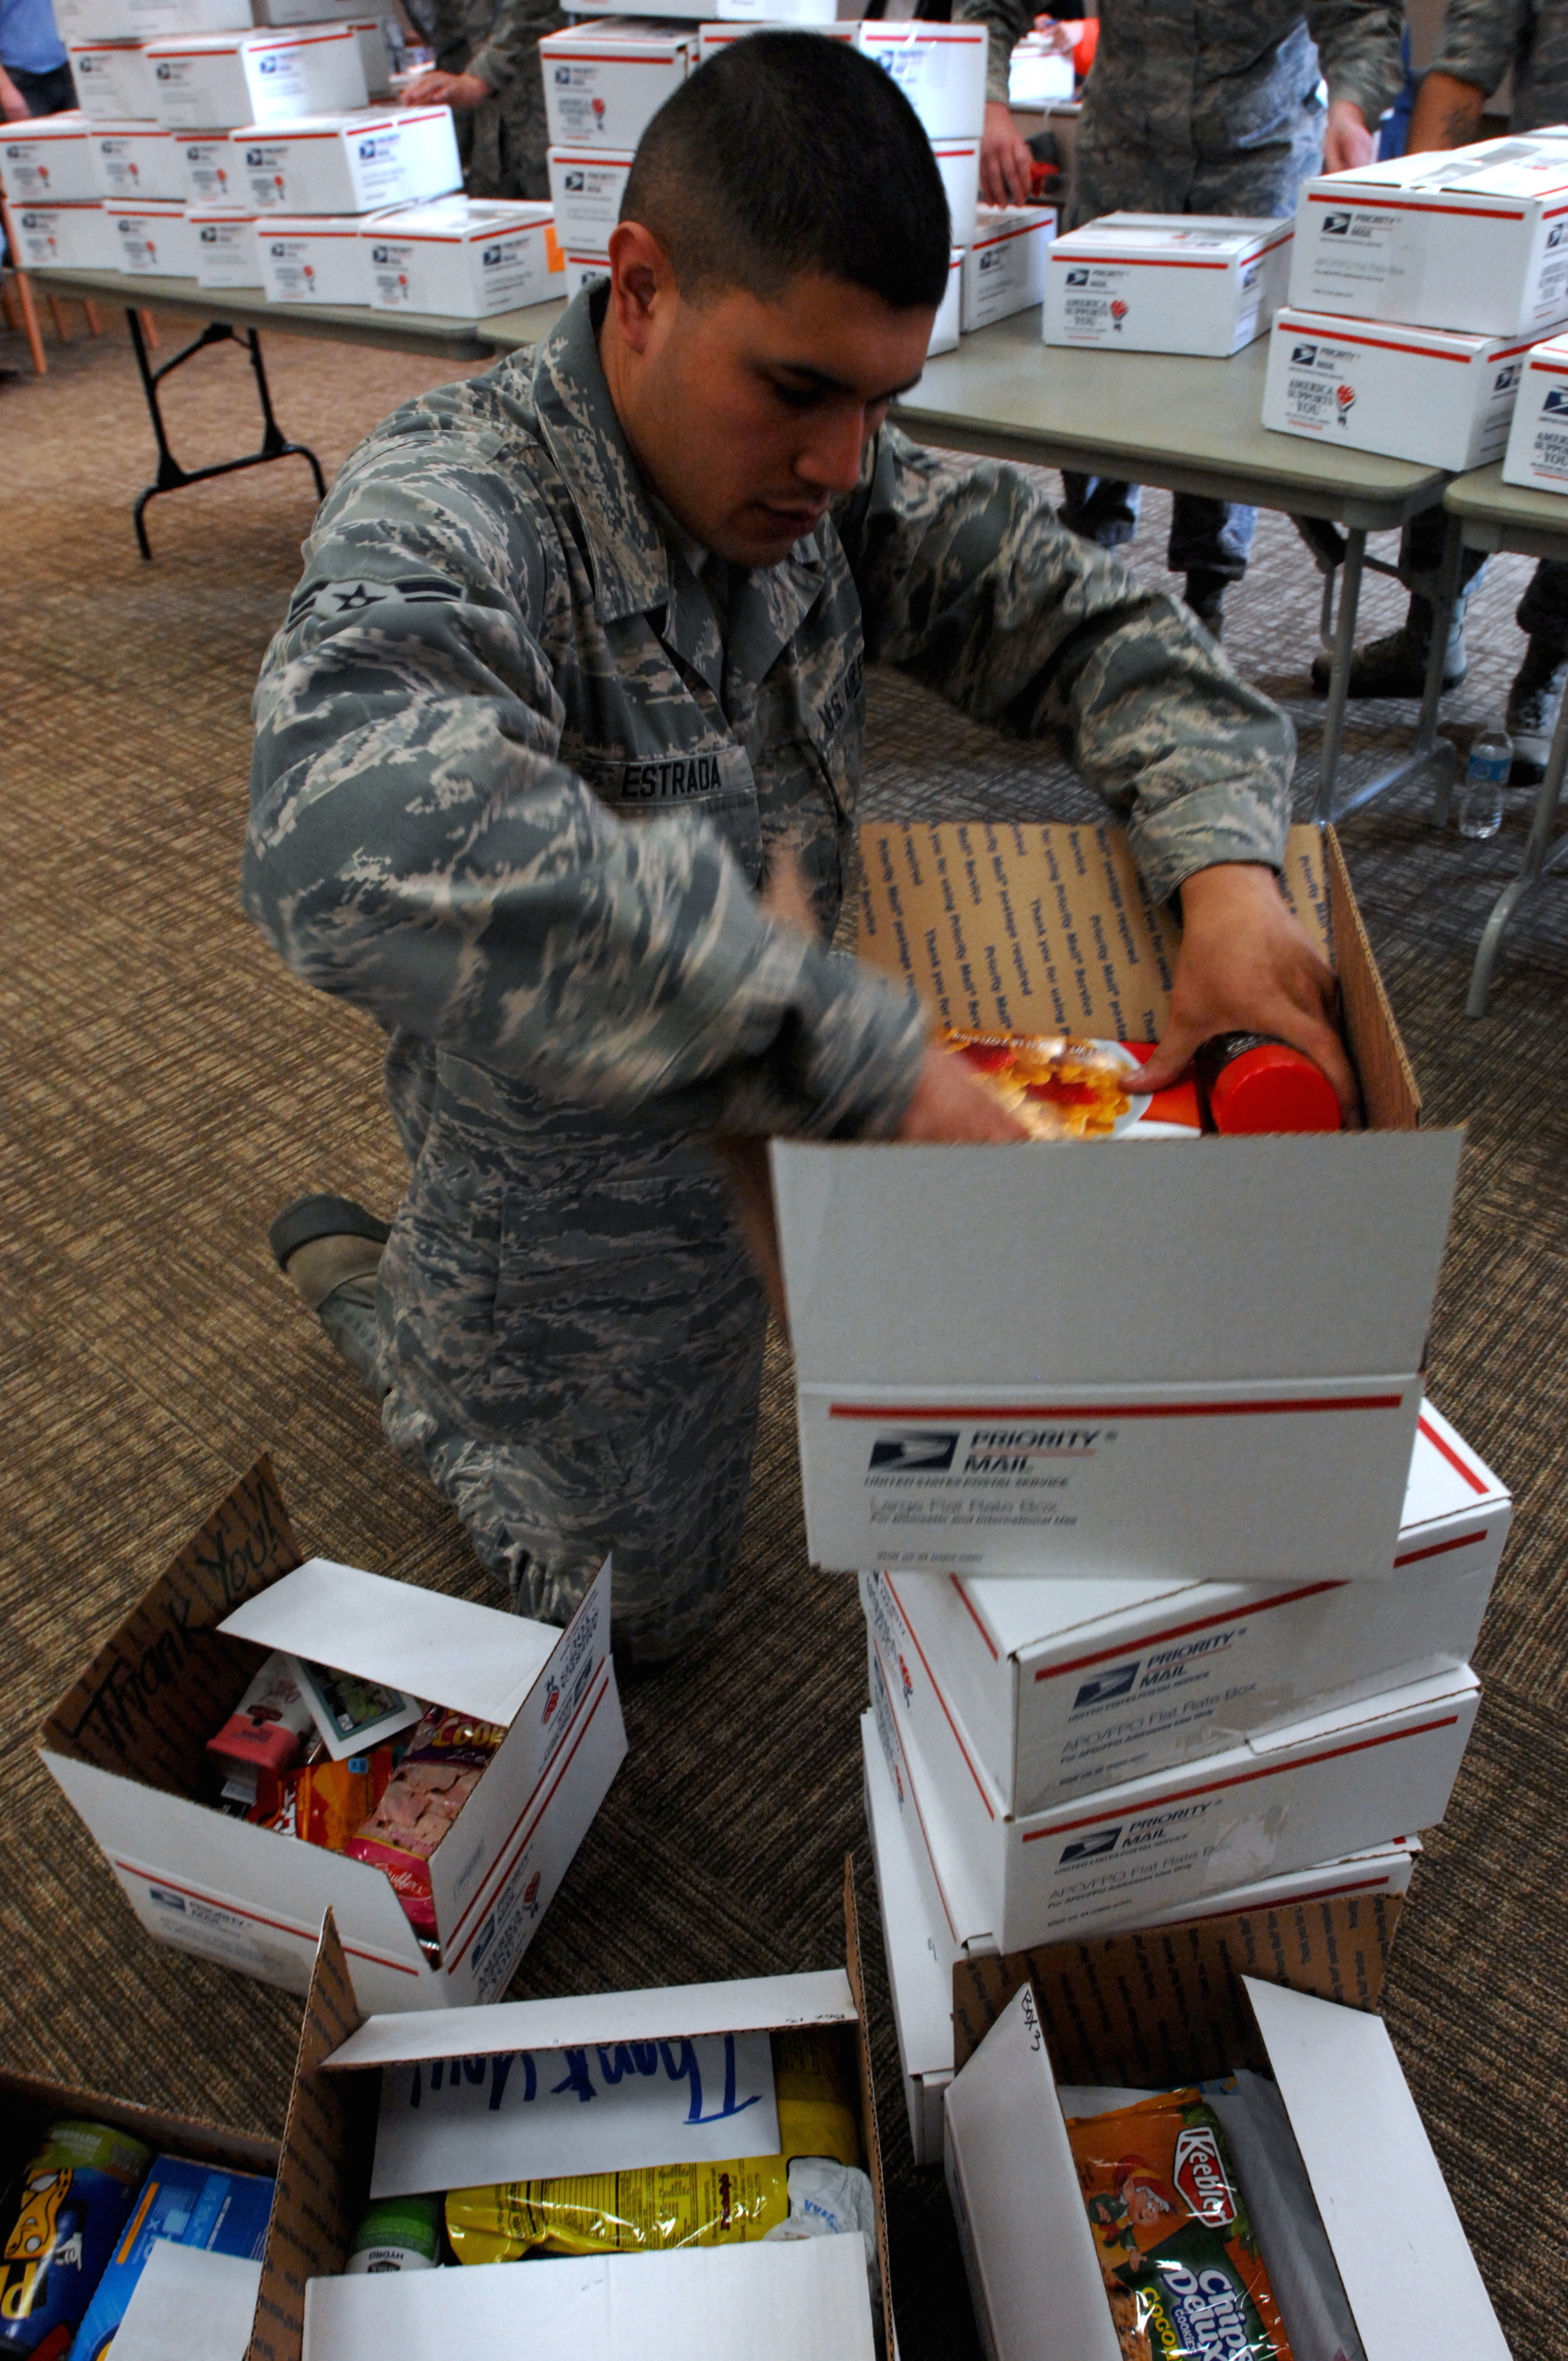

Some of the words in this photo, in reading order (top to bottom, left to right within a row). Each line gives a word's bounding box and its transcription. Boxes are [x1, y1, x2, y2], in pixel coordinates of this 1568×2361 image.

[622, 756, 722, 797] ESTRADA
[971, 1430, 1099, 1449] PRIORITY
[963, 1454, 1034, 1475] MAIL
[1015, 1476, 1068, 1487] SERVICE
[950, 1514, 974, 1524] and
[976, 1515, 1052, 1526] International
[1054, 1515, 1078, 1526] Use
[70, 1597, 211, 1752] Thank
[194, 1481, 280, 1608] You!
[1147, 1629, 1236, 1668] PRIORITY
[1139, 1664, 1189, 1690] MAIL
[1148, 1707, 1178, 1726] Flat
[1183, 1695, 1220, 1715] Rate
[1224, 1682, 1256, 1701] Box
[1129, 1801, 1212, 1832] PRIORITY
[1121, 1829, 1167, 1849] MAIL
[1131, 1862, 1158, 1876] Flat
[1163, 1853, 1199, 1868] Rate
[1047, 1900, 1061, 1910] For
[1030, 2030, 1041, 2052] 3
[1177, 2130, 1230, 2227] Keebler
[368, 2250, 404, 2261] HYDRO
[1162, 2266, 1228, 2361] Delux
[1199, 2268, 1256, 2361] Chips
[1174, 2308, 1197, 2352] COOKIES
